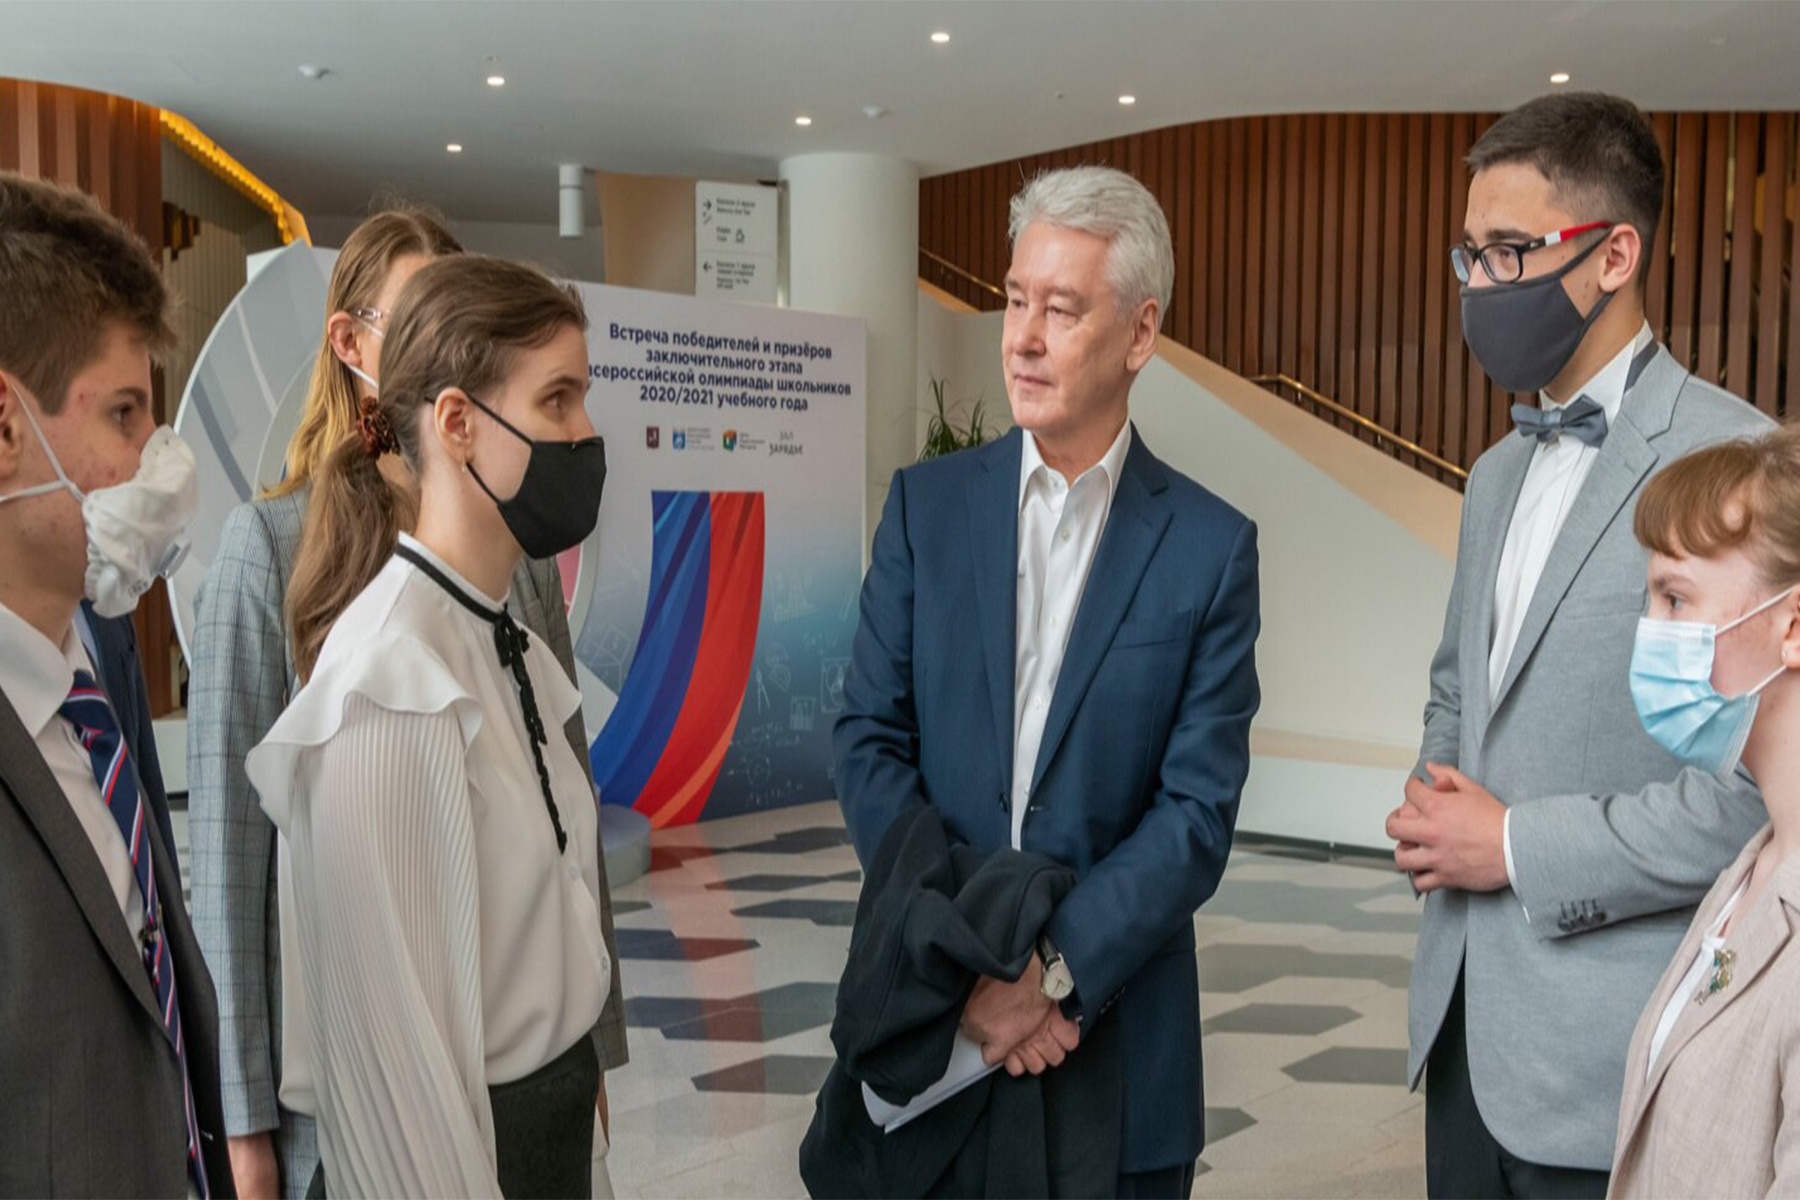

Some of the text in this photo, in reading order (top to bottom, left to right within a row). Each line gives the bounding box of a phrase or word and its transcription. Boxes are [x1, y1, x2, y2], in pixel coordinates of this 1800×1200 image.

[609, 323, 832, 360] Встреча победителей и призёров
[646, 348, 803, 374] заключительного этапа
[698, 372, 773, 392] олимпиады
[776, 379, 851, 396] школьников
[639, 384, 808, 412] 2020/2021 учебного года
